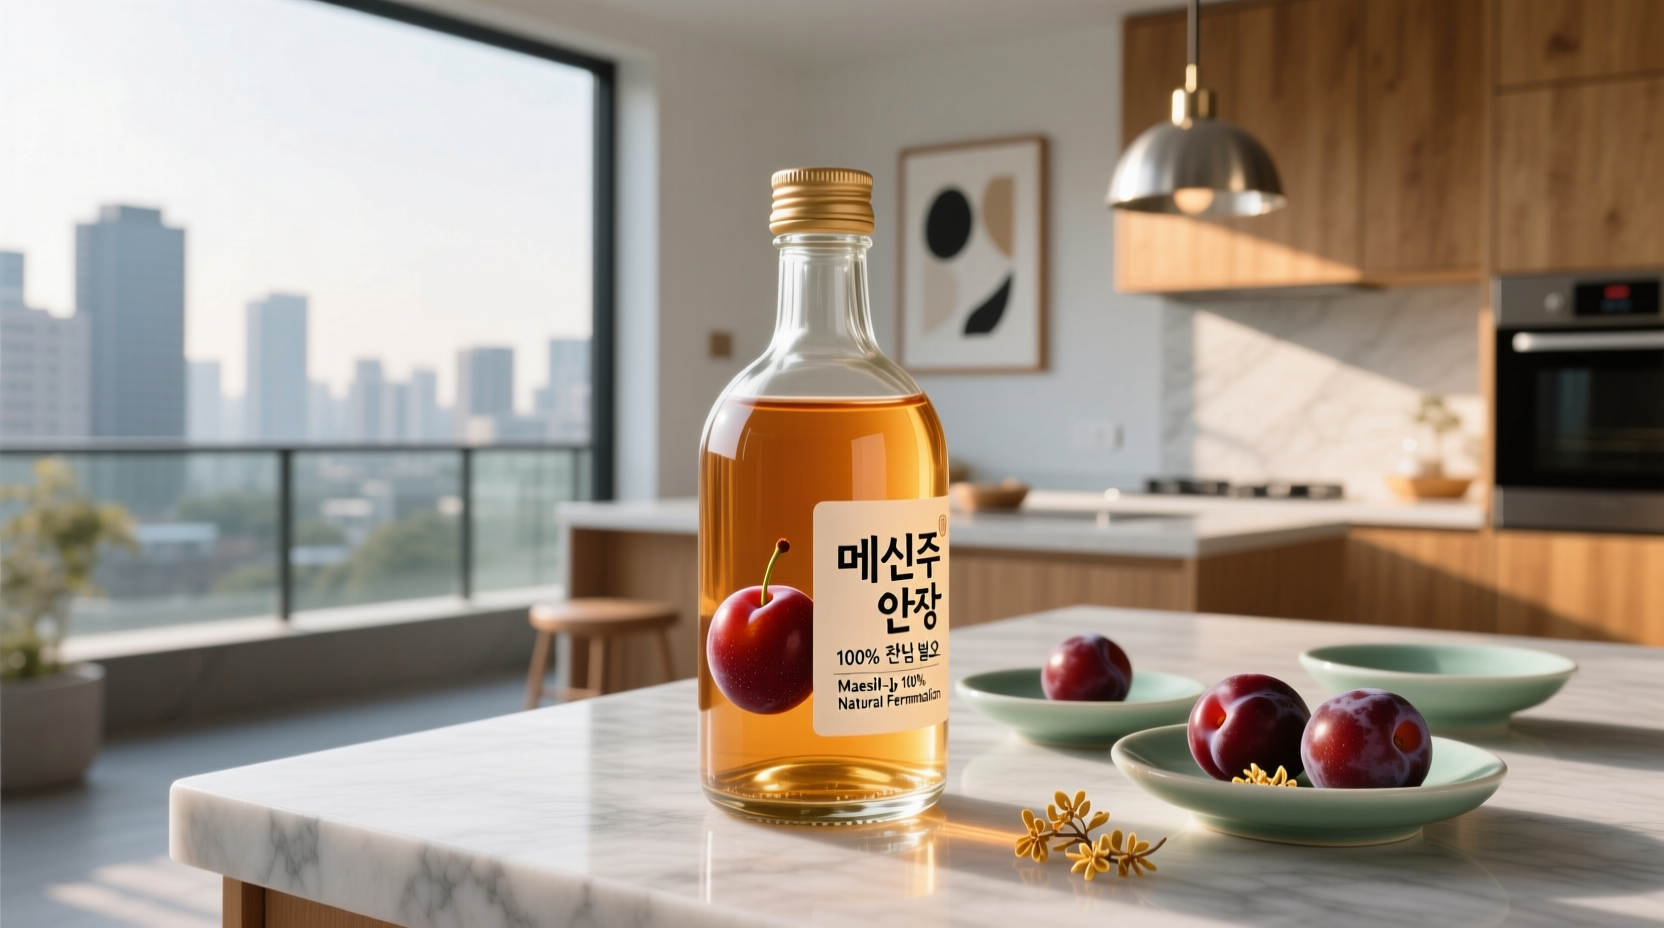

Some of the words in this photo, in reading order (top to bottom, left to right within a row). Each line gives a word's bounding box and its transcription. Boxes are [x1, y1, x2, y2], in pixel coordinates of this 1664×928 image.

[838, 532, 940, 584] 메신주
[878, 582, 942, 634] 안장
[836, 648, 880, 666] 100%
[838, 695, 883, 710] Natural
